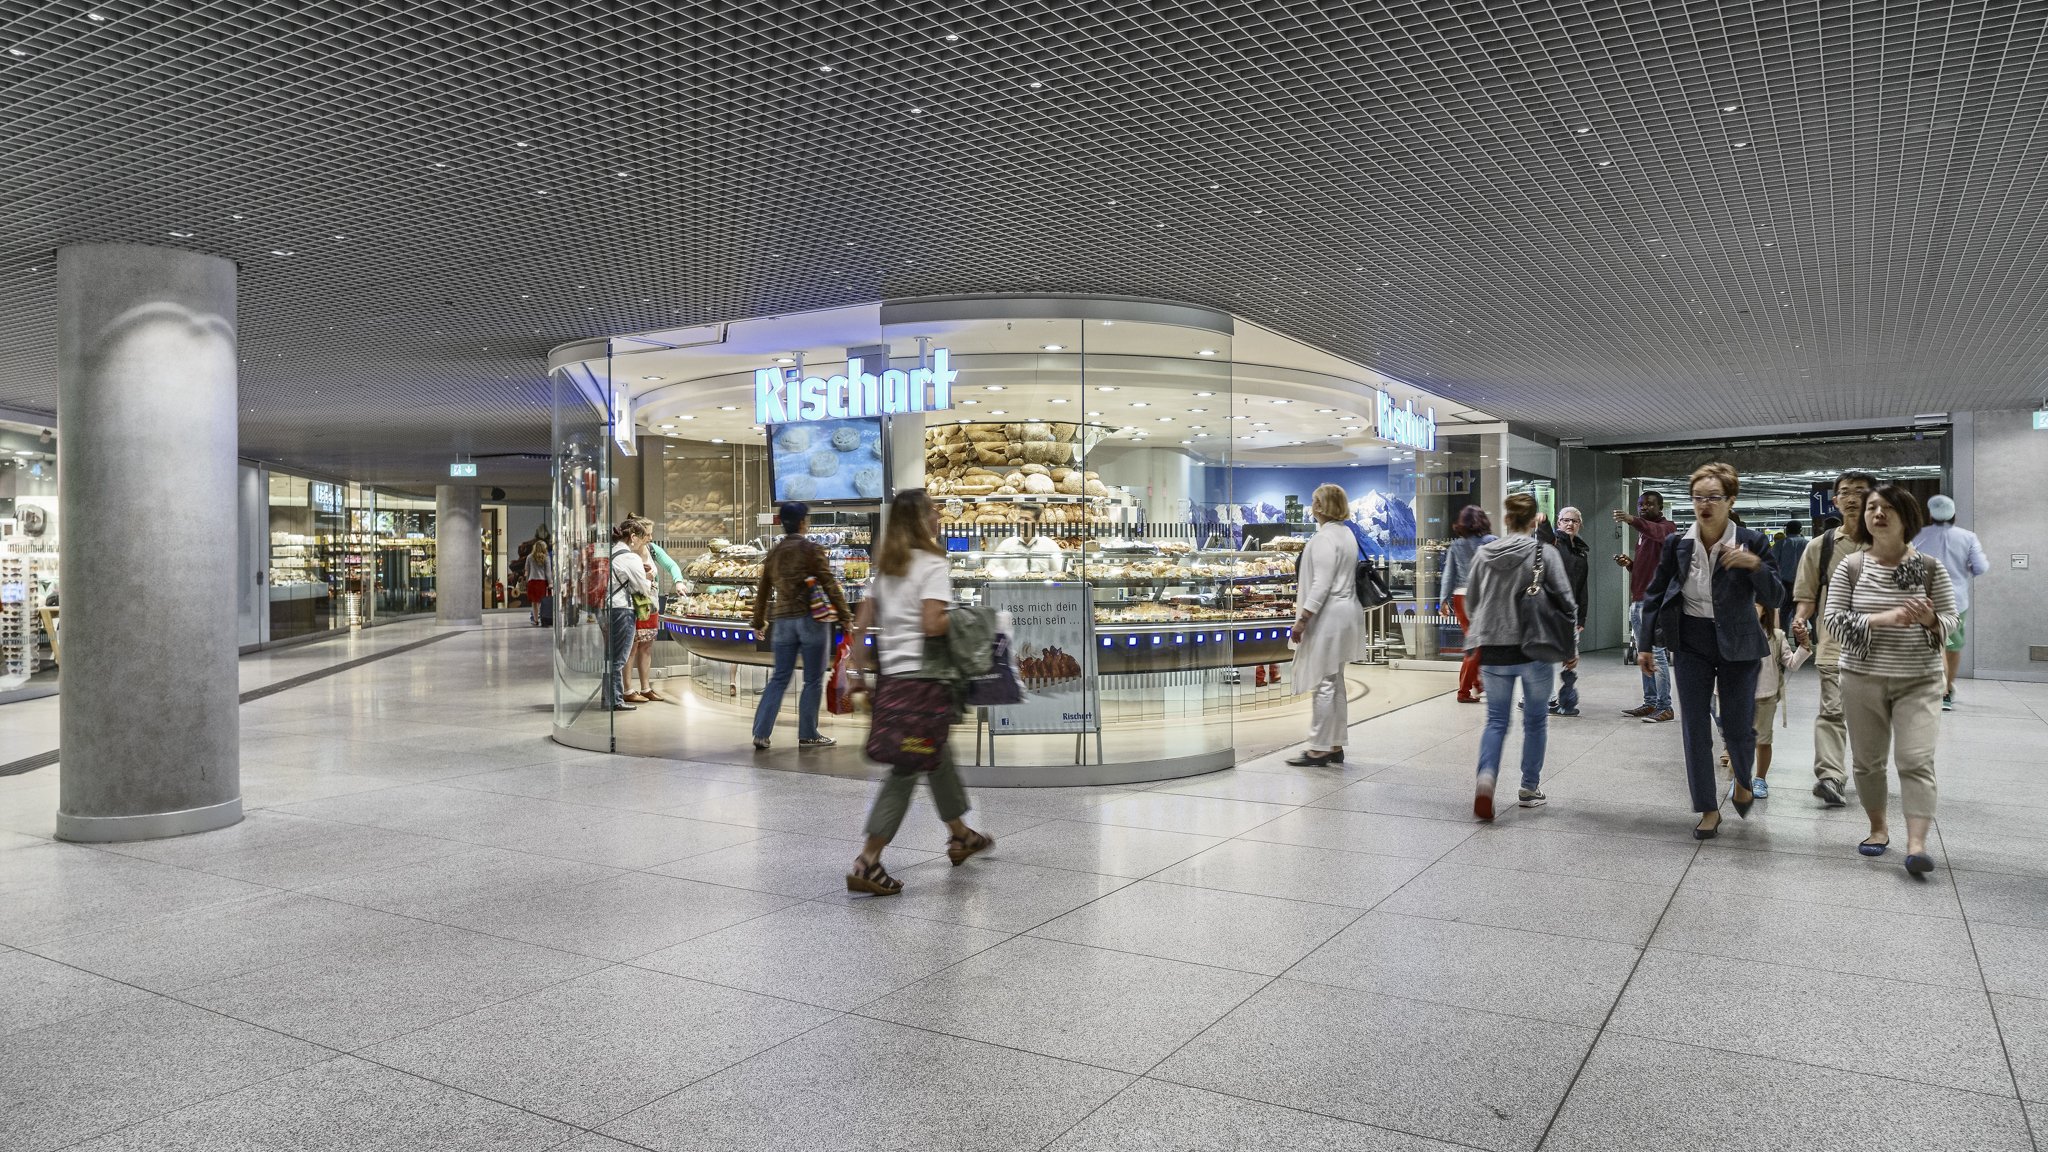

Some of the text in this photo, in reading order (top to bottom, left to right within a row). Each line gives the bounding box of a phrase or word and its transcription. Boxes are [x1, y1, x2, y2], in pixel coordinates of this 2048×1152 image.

[755, 348, 959, 424] Rischart
[1377, 390, 1437, 451] Rischart
[1009, 616, 1042, 626] atschi
[1045, 615, 1066, 625] sein
[1028, 602, 1052, 612] mich
[1056, 602, 1077, 611] dein
